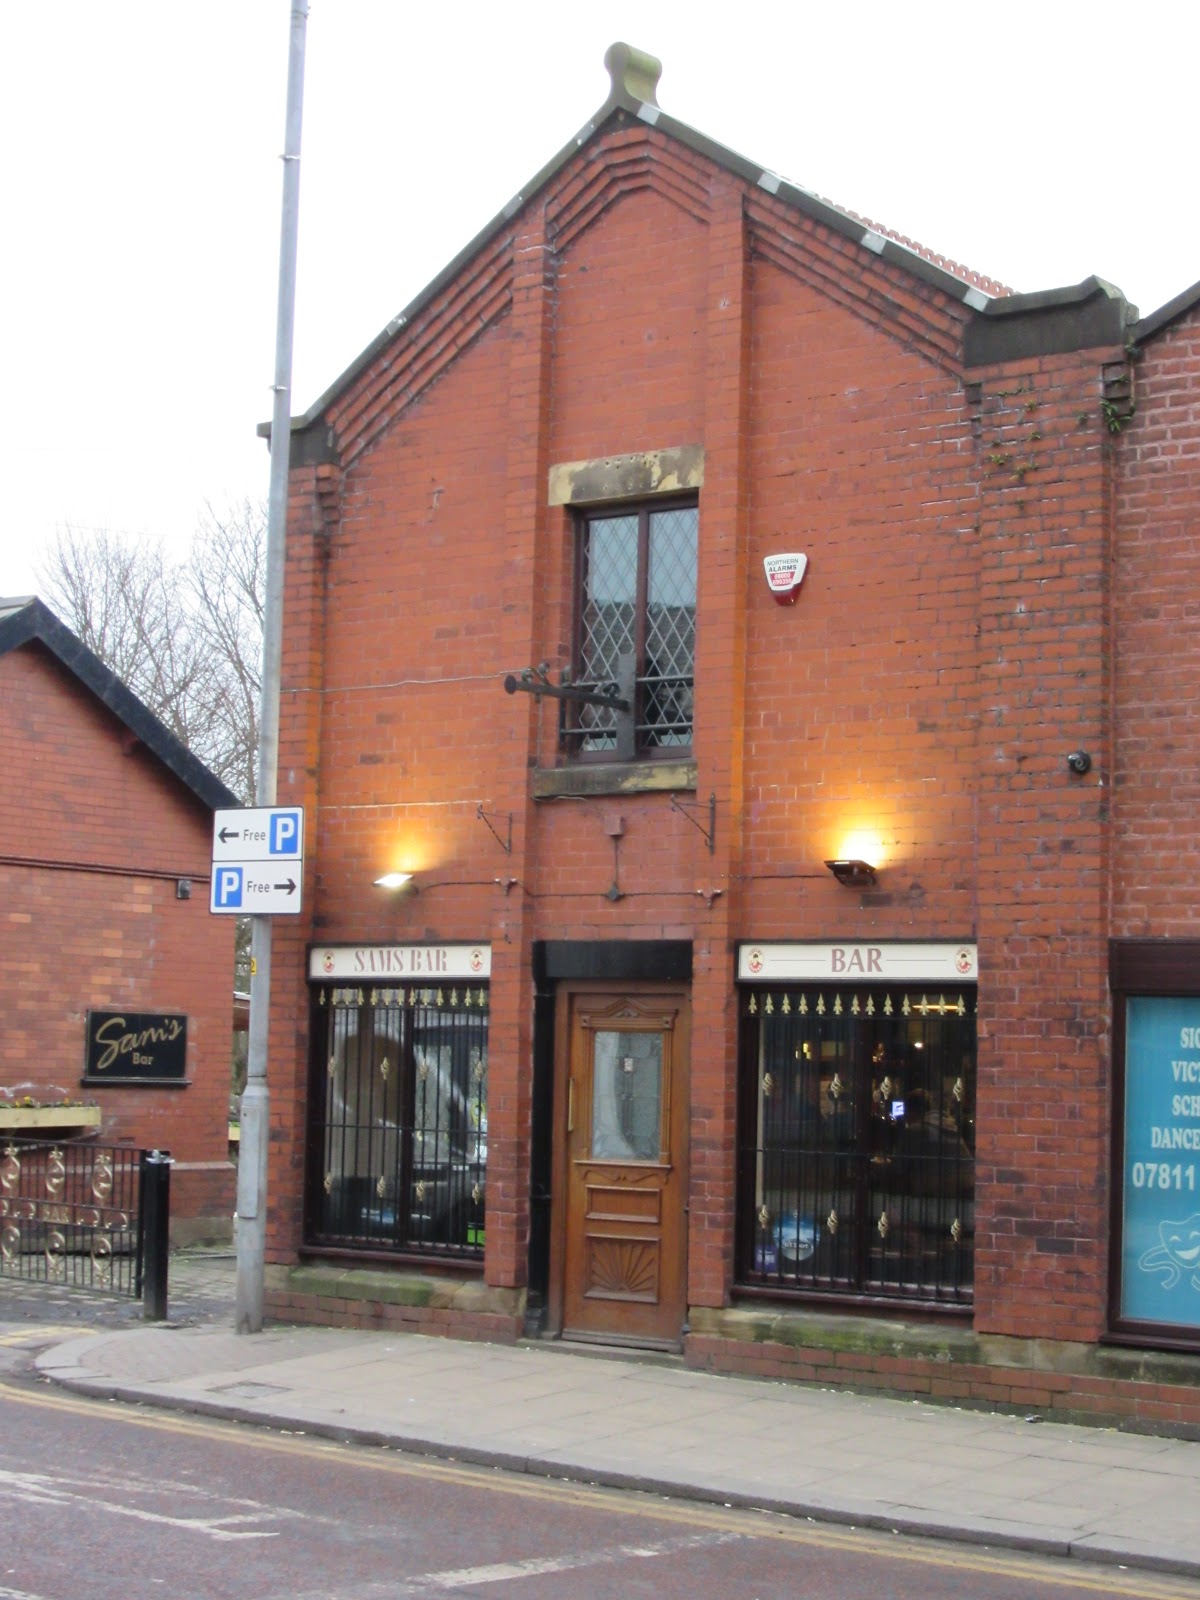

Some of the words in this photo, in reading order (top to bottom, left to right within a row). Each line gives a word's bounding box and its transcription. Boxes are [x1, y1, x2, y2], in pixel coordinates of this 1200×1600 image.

[243, 829, 266, 841] Free
[275, 817, 295, 851] P
[221, 871, 240, 904] P
[247, 881, 270, 893] Free
[354, 949, 404, 973] SAMS
[410, 948, 448, 972] BAR
[831, 948, 883, 973] BAR
[96, 1017, 182, 1069] Sam's
[132, 1053, 154, 1065] Bar
[1151, 1127, 1200, 1150] DANCE
[1132, 1162, 1195, 1190] 07811
